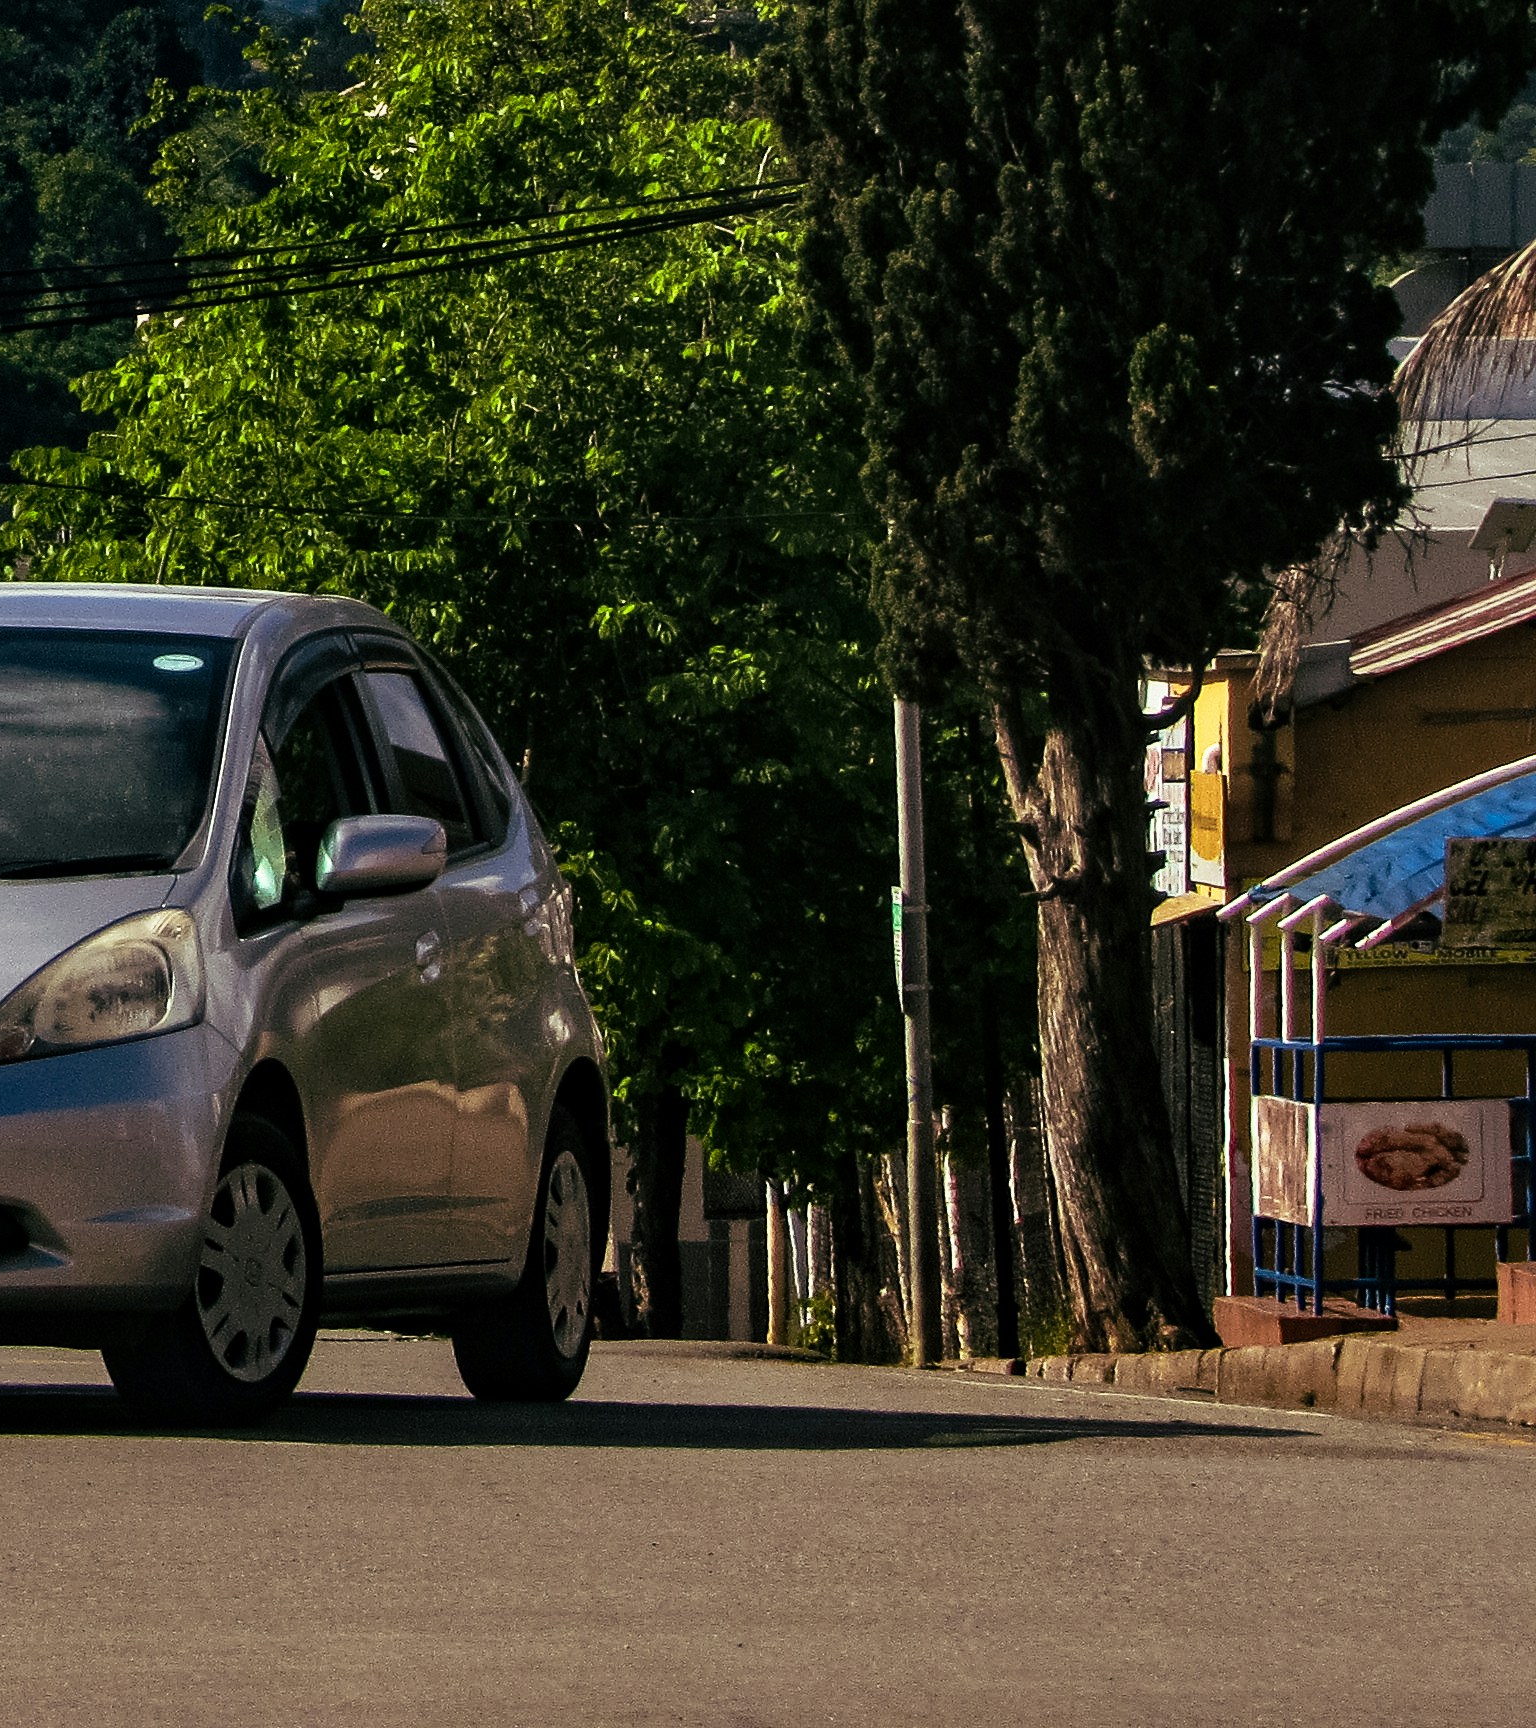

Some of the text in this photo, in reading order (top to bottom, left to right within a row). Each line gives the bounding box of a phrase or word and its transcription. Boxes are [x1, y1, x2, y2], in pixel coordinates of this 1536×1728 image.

[1345, 949, 1409, 960] YELLOW
[1364, 1206, 1473, 1220] FRIED CHICKEN
